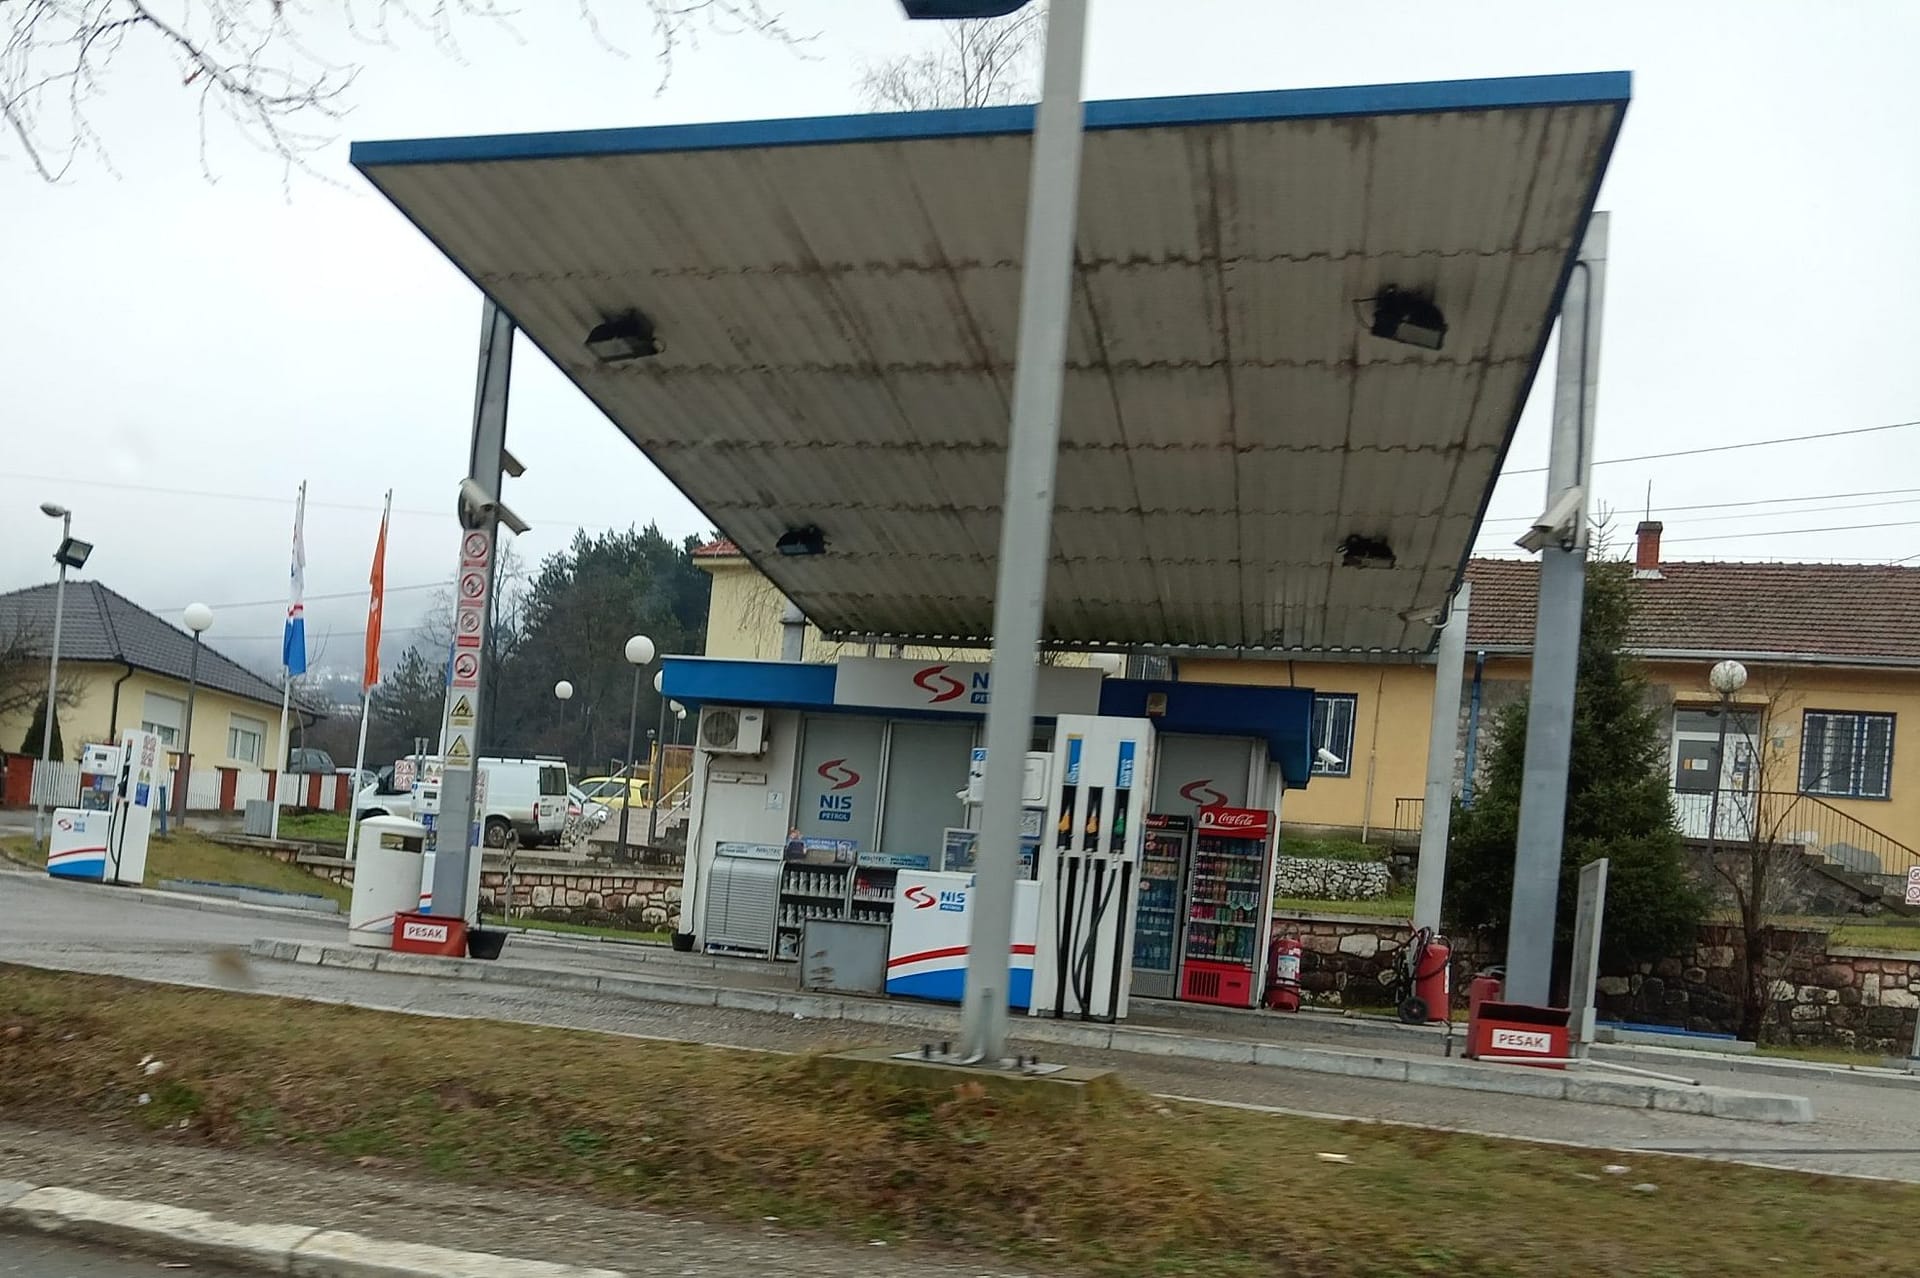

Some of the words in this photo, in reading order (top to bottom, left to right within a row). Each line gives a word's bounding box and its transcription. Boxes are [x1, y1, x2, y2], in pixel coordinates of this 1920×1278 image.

[820, 794, 852, 810] NIS
[1218, 813, 1255, 826] Coca-Cola
[941, 891, 965, 903] NIS
[408, 926, 442, 938] PESAK
[1499, 1033, 1544, 1048] PESAK
